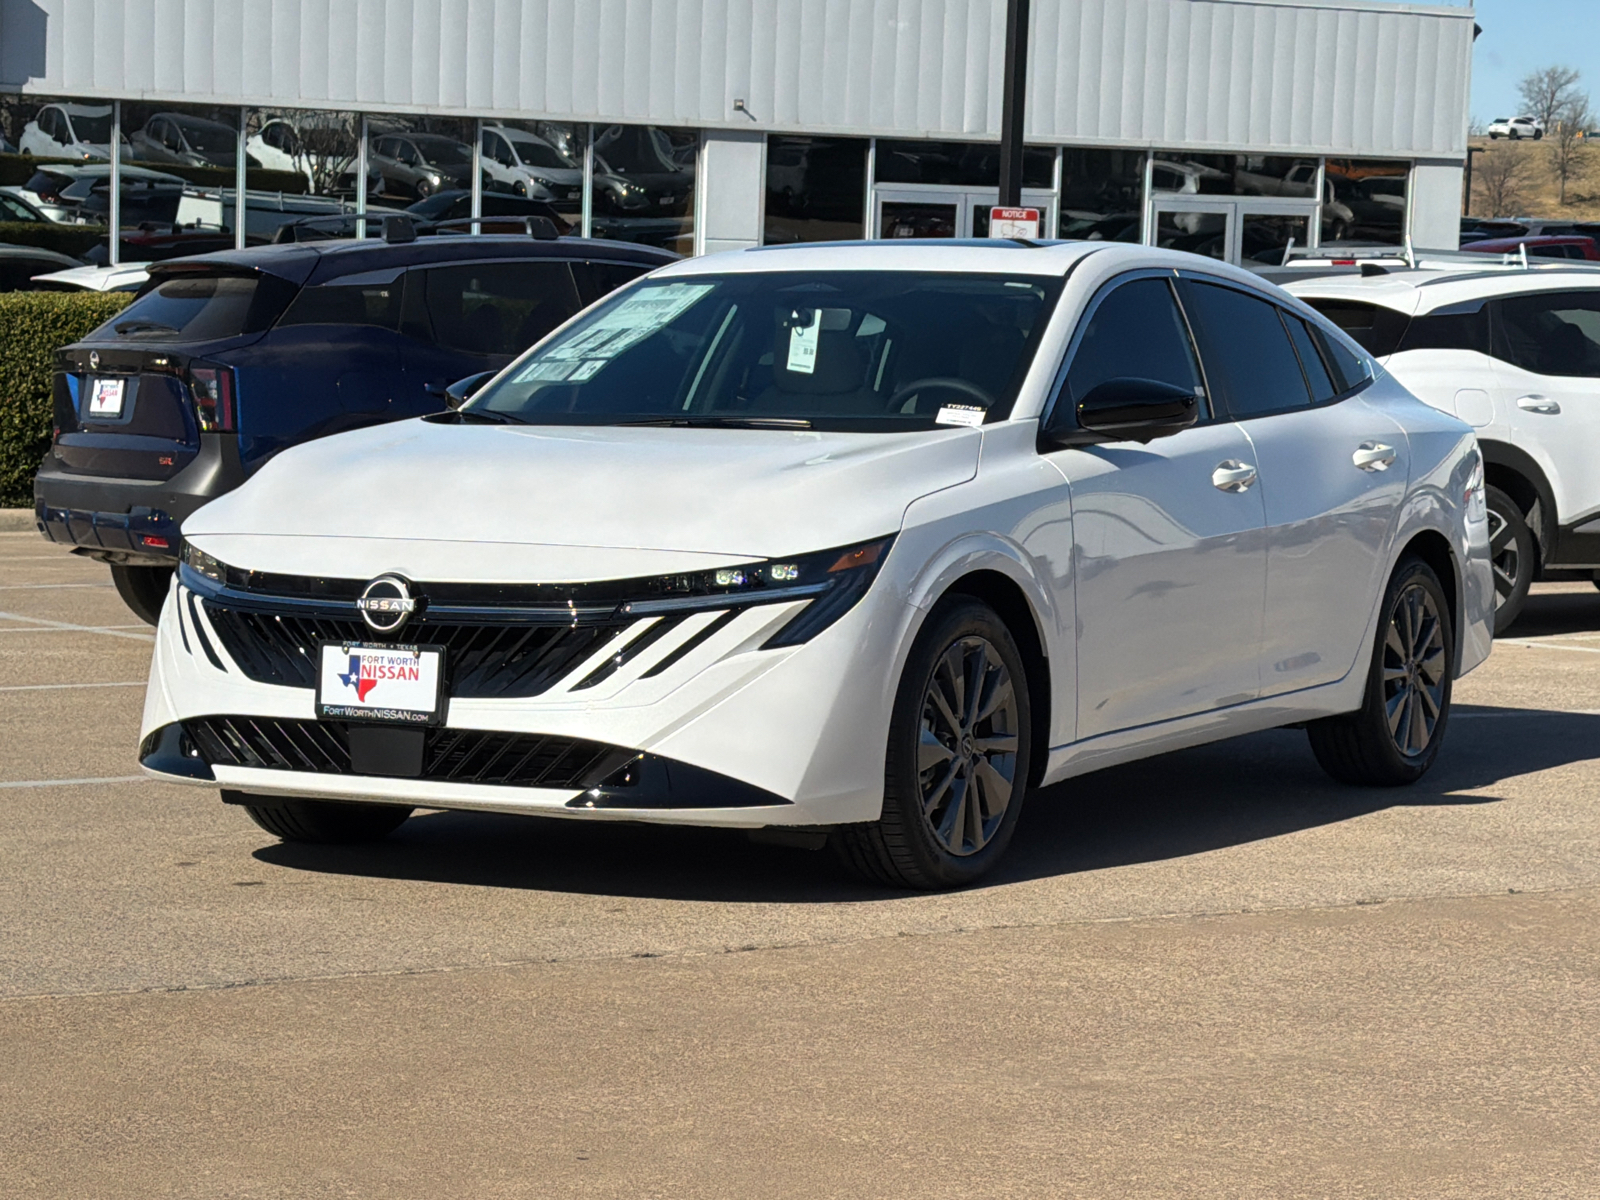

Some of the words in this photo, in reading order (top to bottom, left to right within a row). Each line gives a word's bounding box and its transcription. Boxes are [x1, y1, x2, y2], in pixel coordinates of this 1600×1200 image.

[1001, 210, 1027, 219] NOTICE
[357, 599, 412, 610] NISSAN
[343, 641, 360, 649] FORT
[363, 641, 386, 650] WORTH
[396, 643, 418, 651] TEXAS
[362, 655, 385, 664] FORT
[388, 656, 419, 667] WORTH
[361, 665, 419, 681] NISSAN
